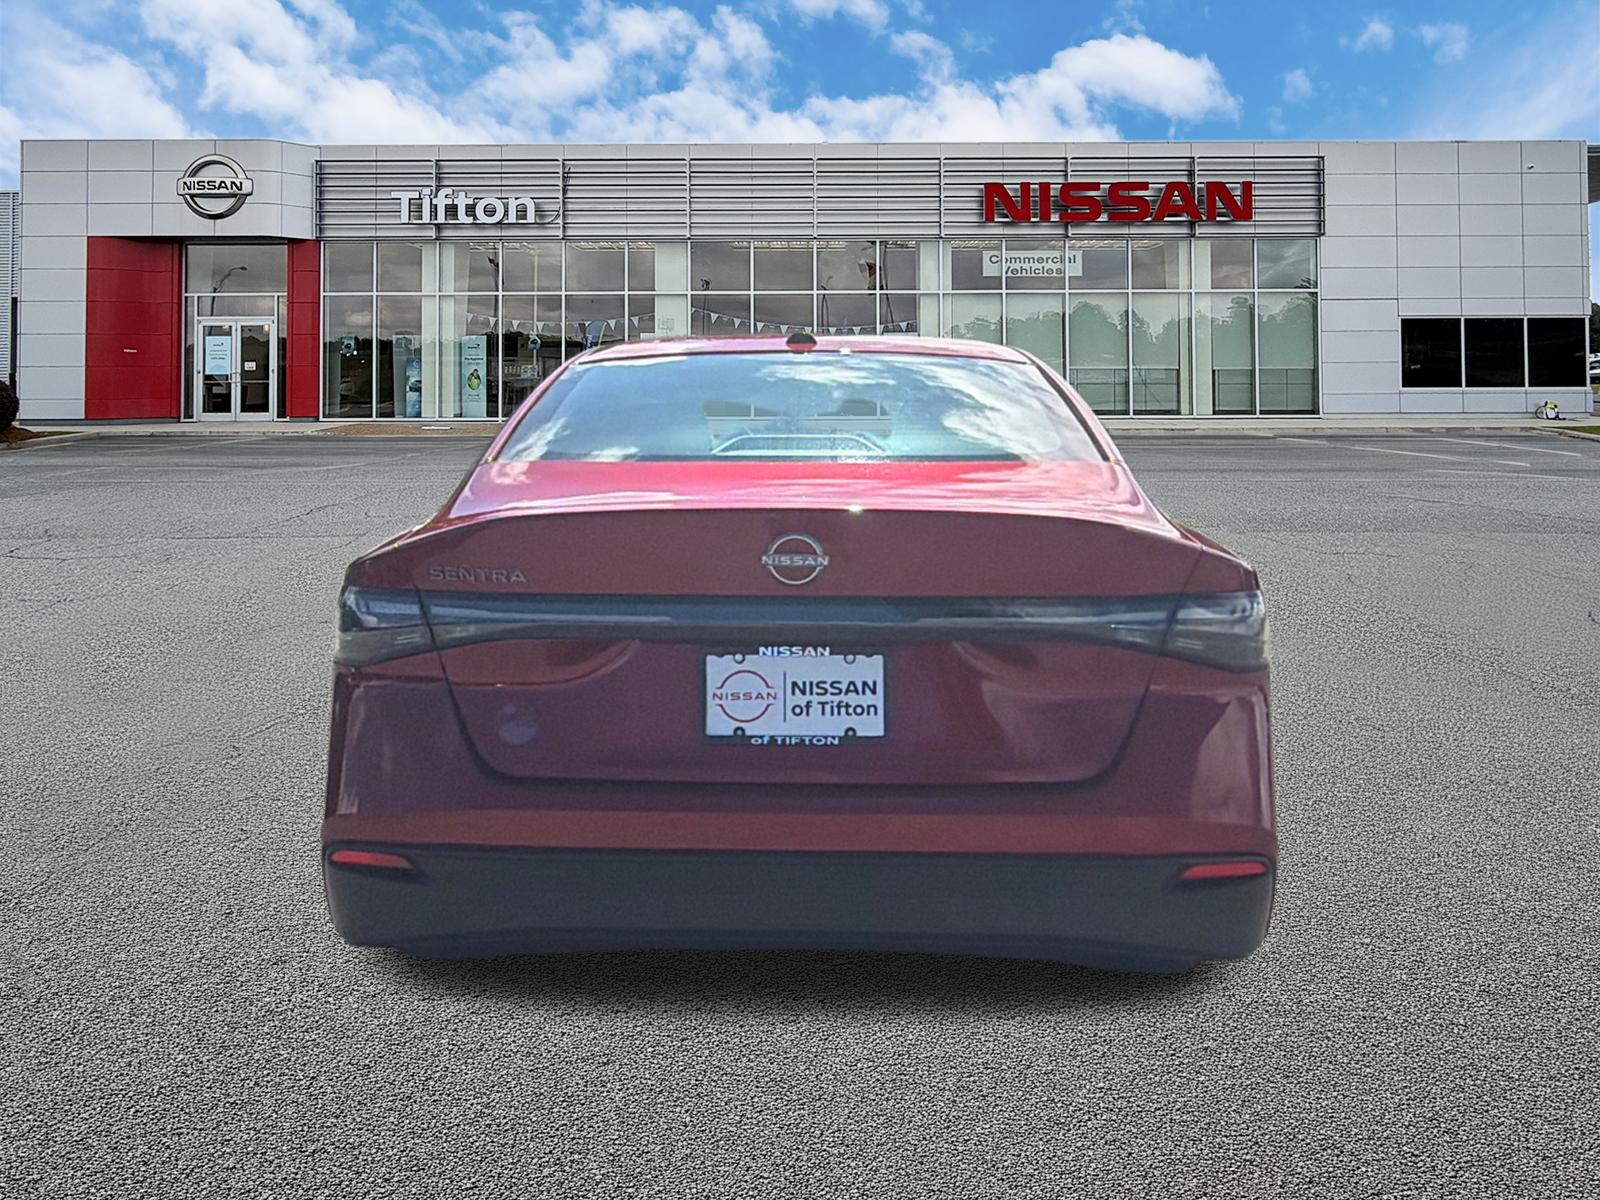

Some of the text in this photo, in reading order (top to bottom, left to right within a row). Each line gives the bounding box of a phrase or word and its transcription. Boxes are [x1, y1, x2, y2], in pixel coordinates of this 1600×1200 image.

[182, 180, 243, 191] NISSAN
[391, 188, 536, 224] Tifton
[984, 181, 1253, 222] NISSAN
[761, 555, 829, 566] NISSAN
[429, 566, 527, 583] SENTRA
[758, 646, 831, 657] NISSAN
[790, 680, 877, 696] NISSAN
[712, 692, 777, 701] NISSAN
[791, 701, 878, 717] of Tifton
[751, 736, 839, 745] of TIFTON
